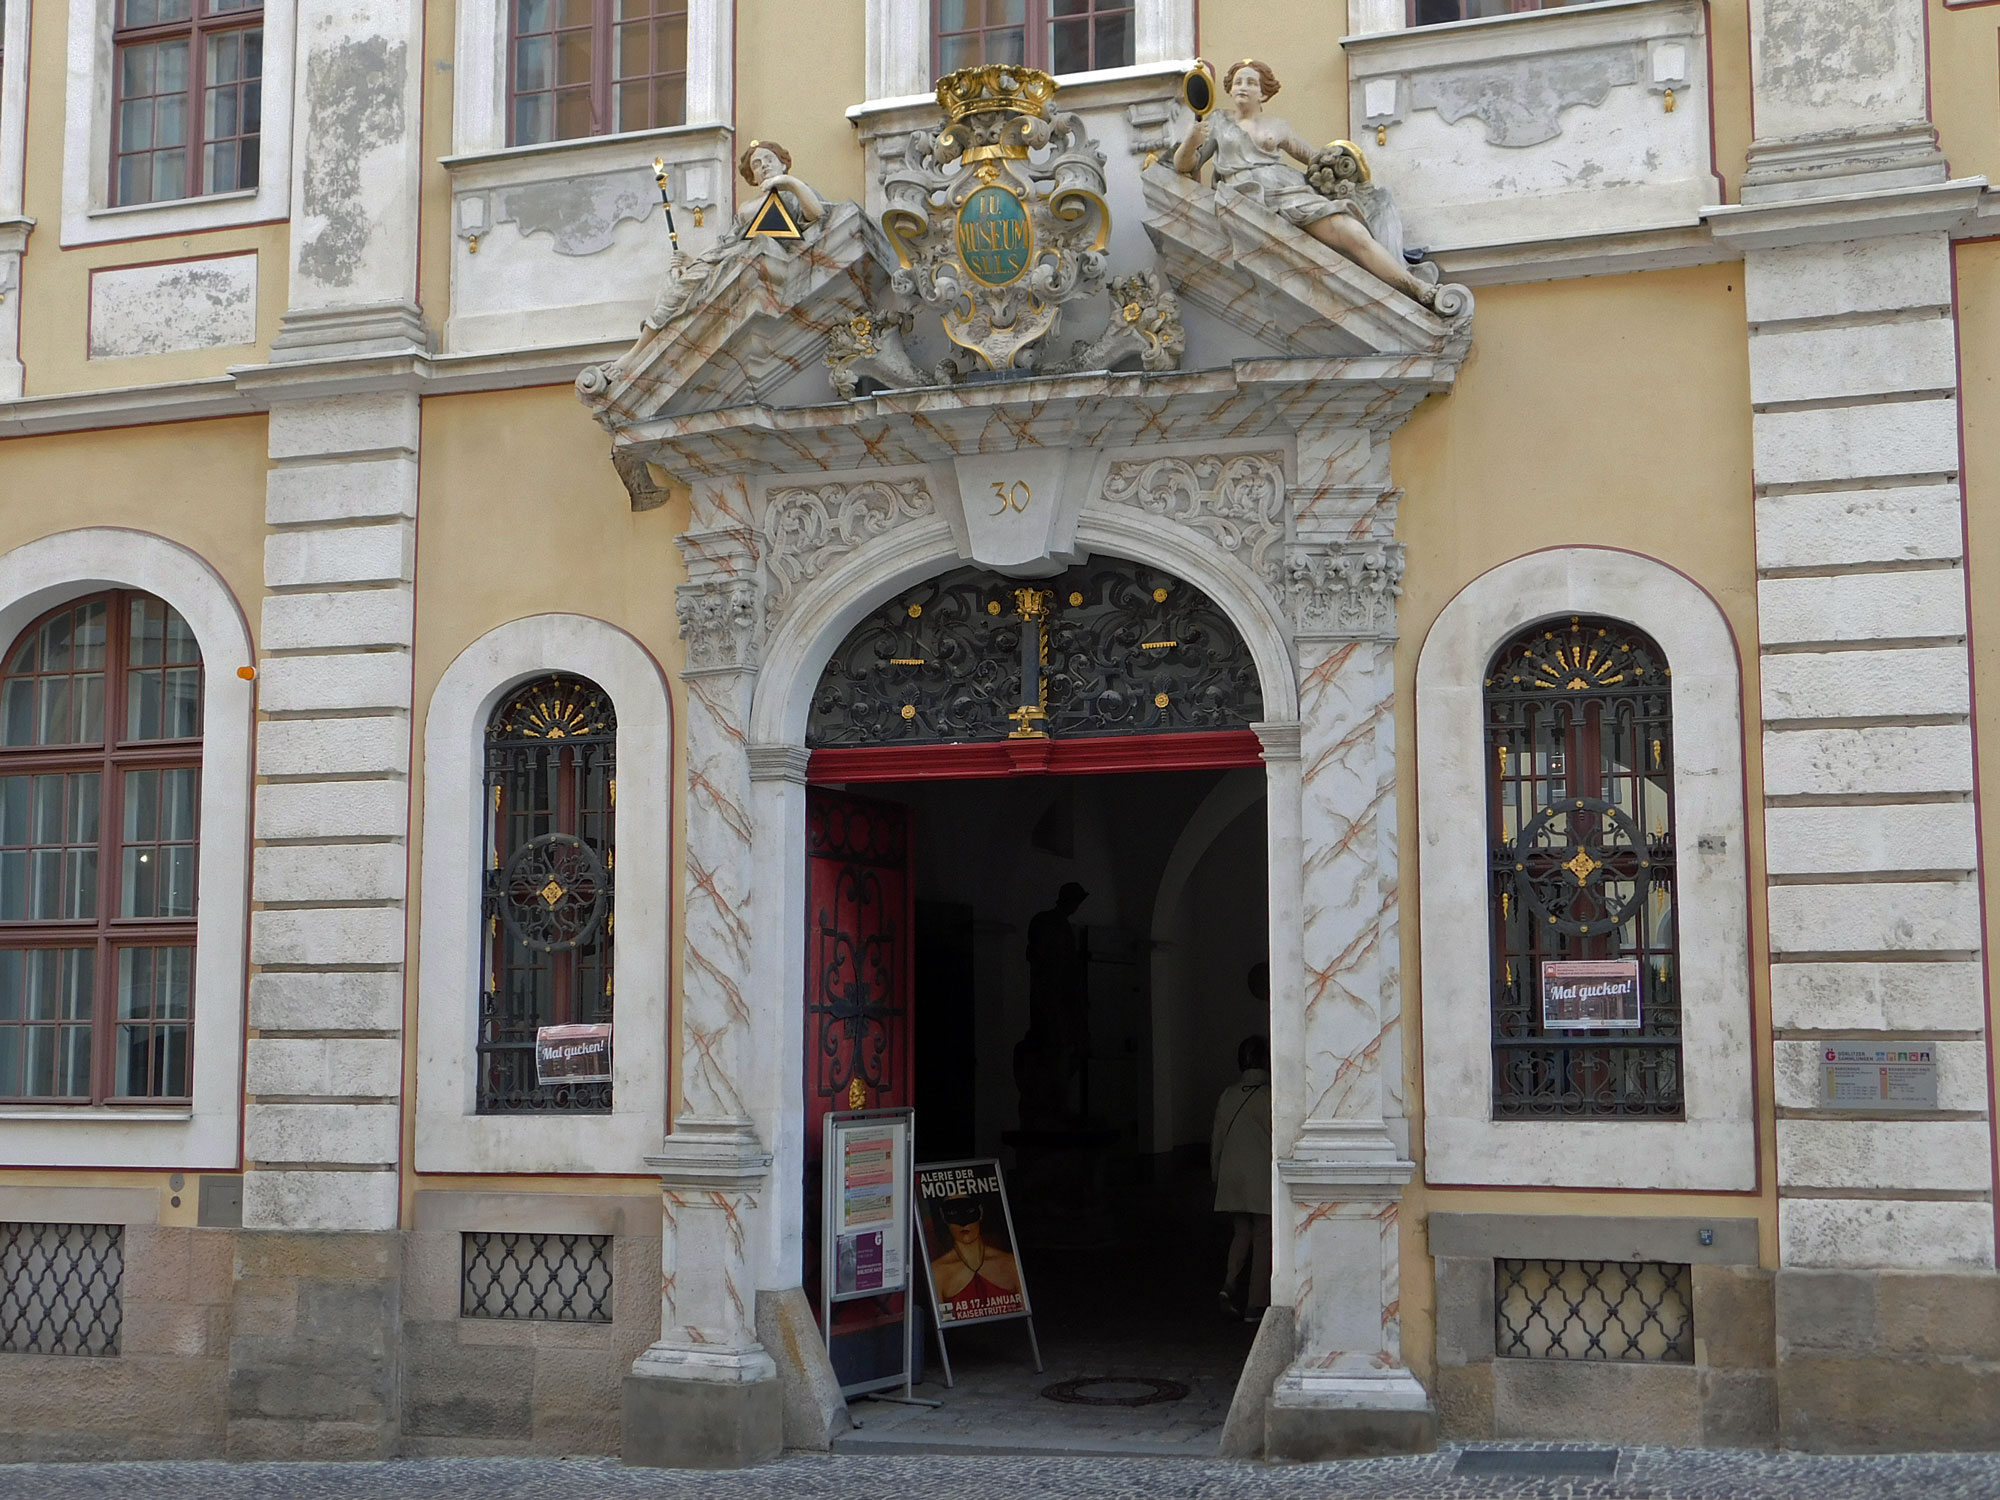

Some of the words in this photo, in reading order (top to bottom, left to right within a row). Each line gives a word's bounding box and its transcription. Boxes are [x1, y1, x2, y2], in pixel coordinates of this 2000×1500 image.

[959, 219, 1029, 252] MUSEUM
[989, 480, 1031, 516] 30
[1550, 985, 1577, 1000] Mal
[1579, 979, 1632, 1001] gucken!
[542, 1047, 562, 1060] Mal
[564, 1040, 604, 1060] gucken!
[919, 1171, 953, 1183] ALERIE
[955, 1169, 974, 1179] DER
[921, 1176, 999, 1199] MODERNE
[955, 1301, 969, 1311] AB
[970, 1299, 984, 1309] 17.
[986, 1294, 1021, 1307] JANUAR
[957, 1306, 1007, 1320] KAISERTRUTZ
